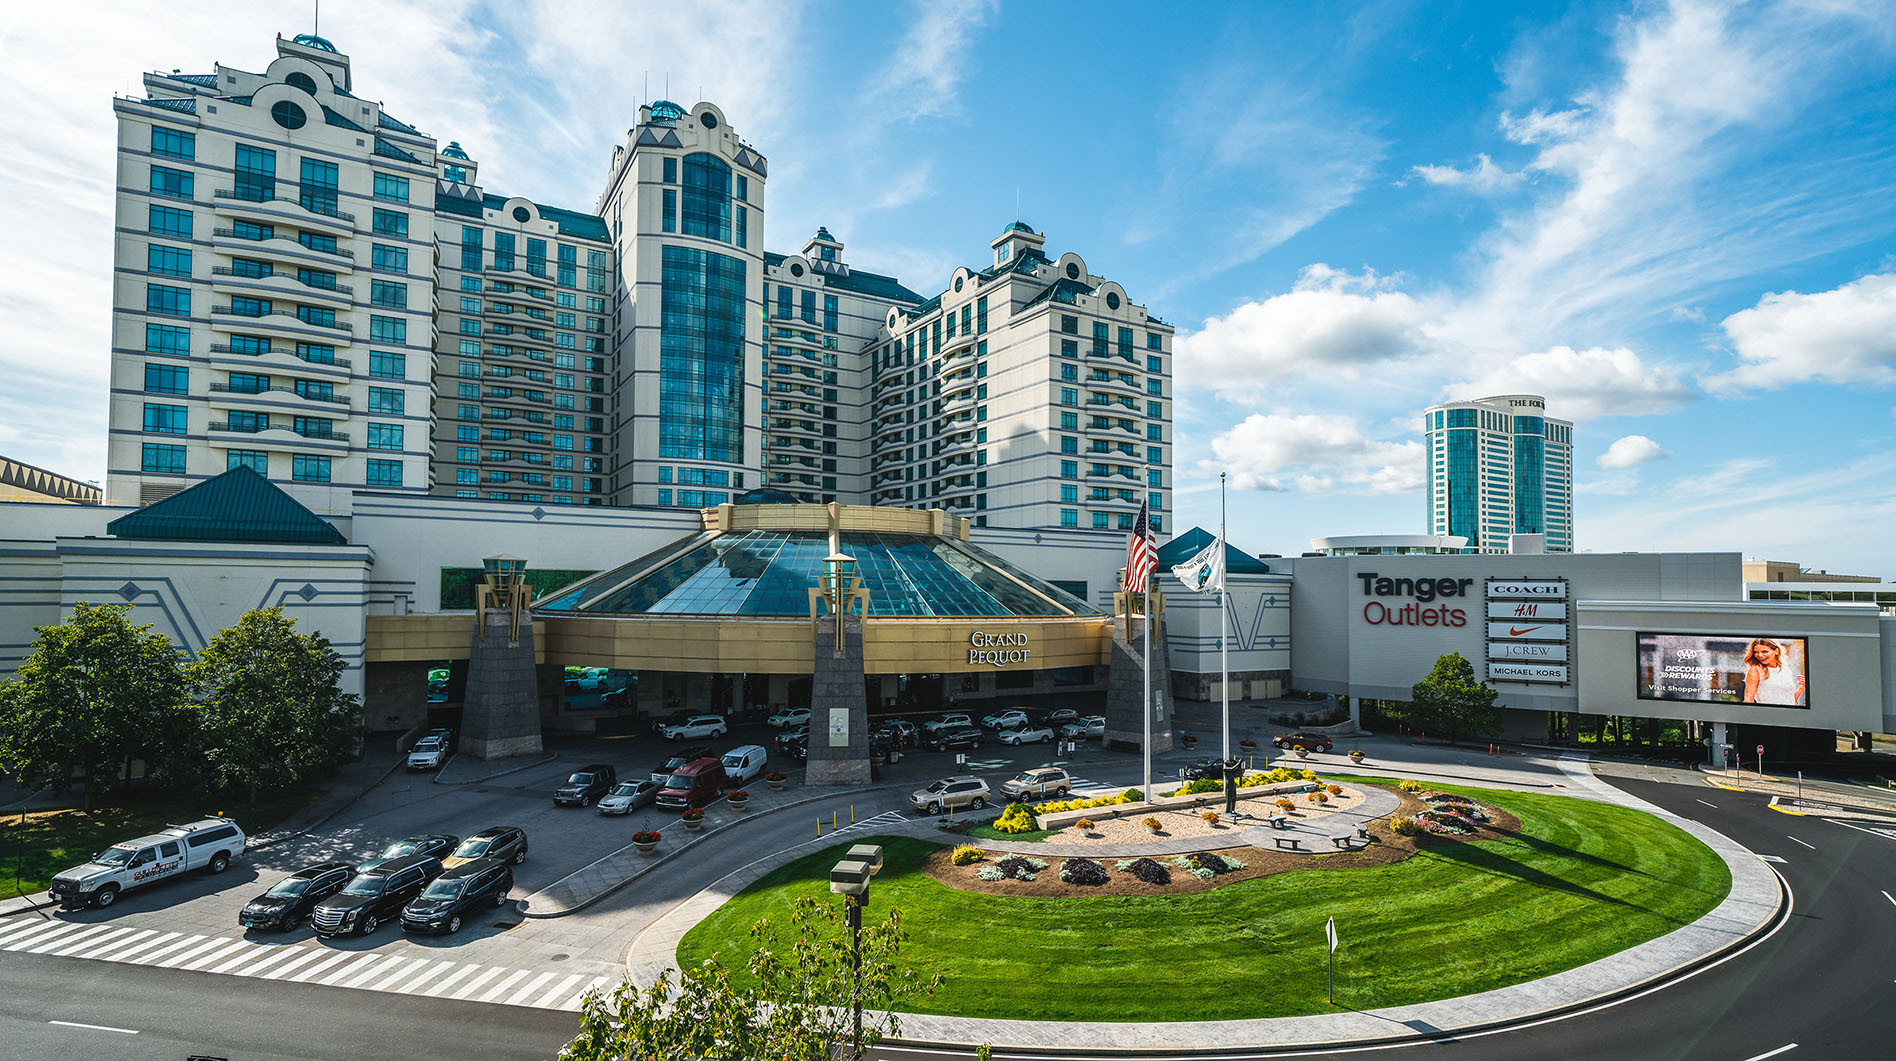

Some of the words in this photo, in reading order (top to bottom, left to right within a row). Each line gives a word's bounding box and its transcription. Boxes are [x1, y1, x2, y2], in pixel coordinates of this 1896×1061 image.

[1508, 399, 1528, 407] THE
[1357, 572, 1473, 602] Tanger
[1494, 586, 1559, 594] COACH
[1364, 601, 1467, 627] Outlets
[1514, 603, 1538, 617] H&M
[971, 631, 1028, 647] GRAND
[1505, 646, 1550, 657] J.CREW
[968, 649, 1031, 667] PEQUOT
[1494, 667, 1533, 676] MICHAEL
[1536, 669, 1561, 677] KORS
[1665, 665, 1716, 674] DISCOUNTS
[1668, 671, 1714, 680] REWARDS
[1667, 685, 1701, 693] Shopper
[1703, 687, 1736, 695] Services
